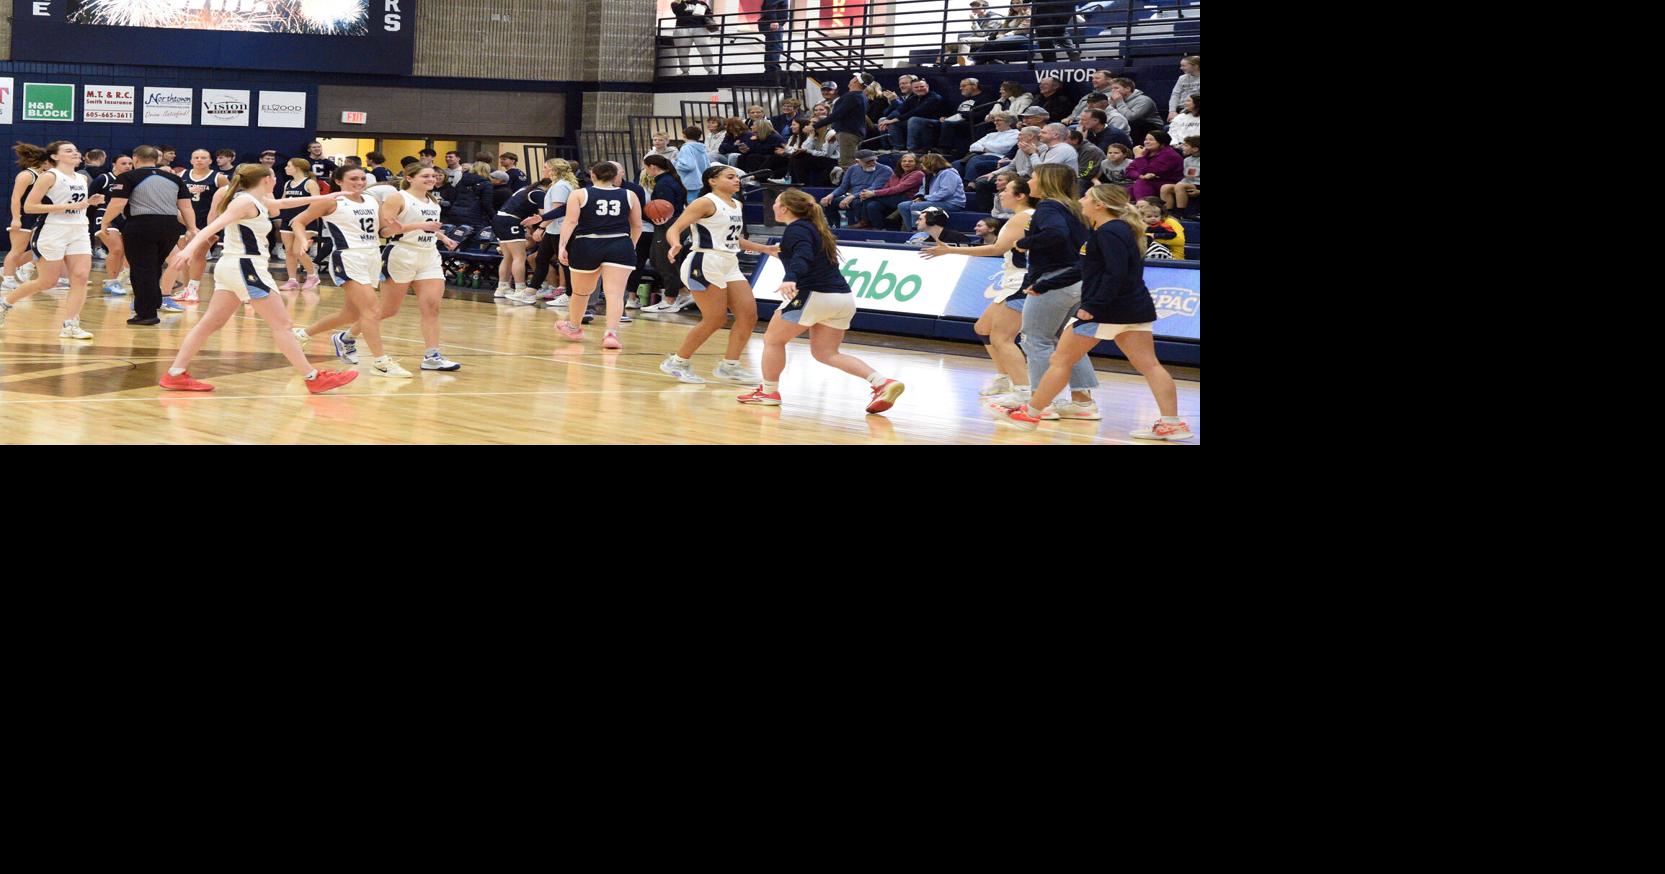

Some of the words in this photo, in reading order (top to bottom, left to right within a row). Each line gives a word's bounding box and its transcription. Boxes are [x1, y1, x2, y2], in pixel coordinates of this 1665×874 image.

[33, 0, 51, 16] E
[86, 90, 103, 98] M.T.
[115, 91, 133, 99] R.C.
[28, 101, 54, 109] H&R
[203, 101, 248, 110] Vision
[261, 103, 302, 111] ELWOOD
[27, 109, 69, 118] BLOCK
[312, 164, 324, 176] C
[595, 199, 621, 216] 33
[359, 217, 375, 233] 12
[510, 226, 519, 234] C
[1151, 294, 1198, 312] PAC
